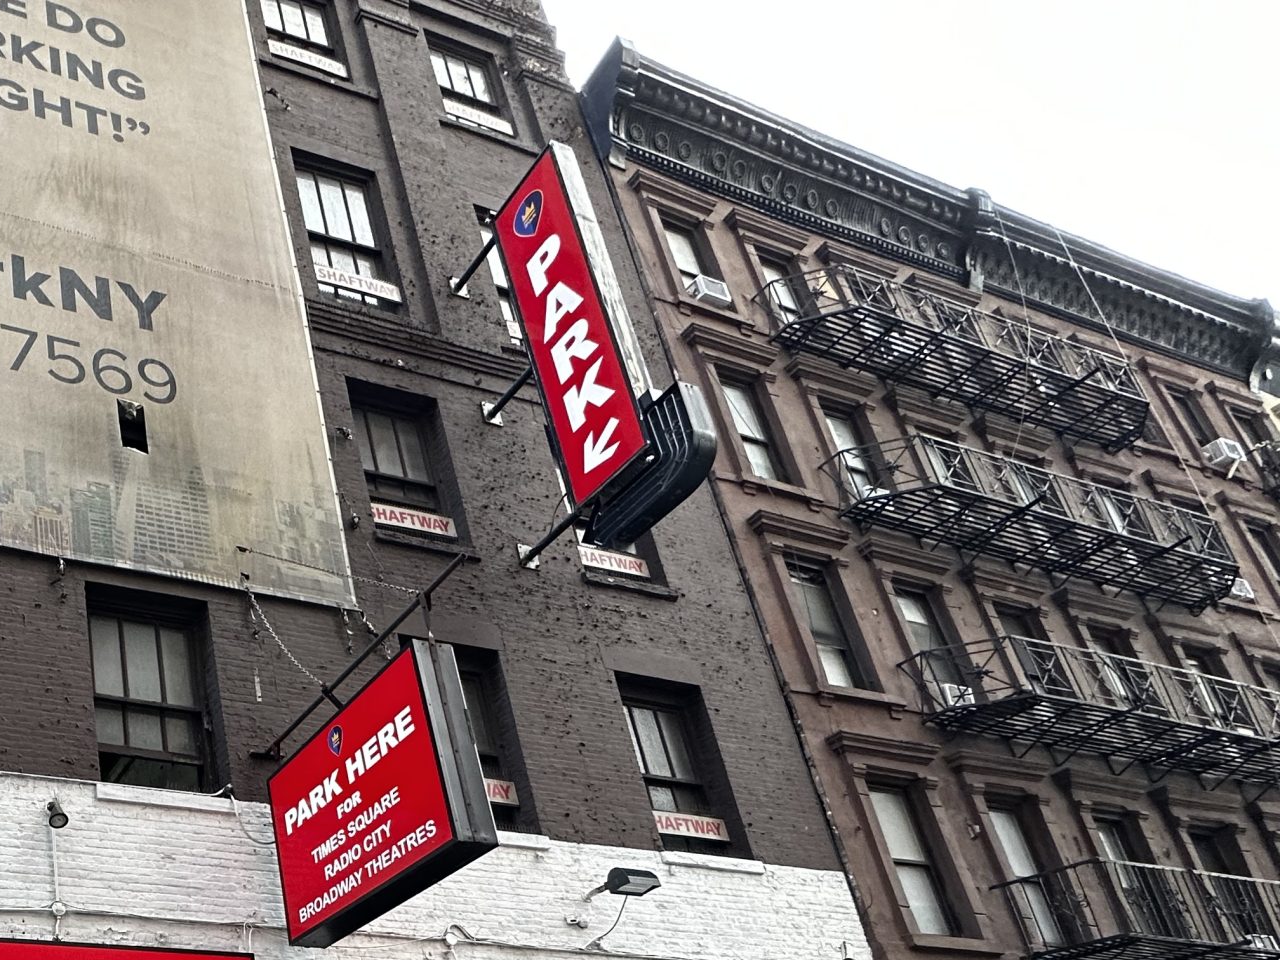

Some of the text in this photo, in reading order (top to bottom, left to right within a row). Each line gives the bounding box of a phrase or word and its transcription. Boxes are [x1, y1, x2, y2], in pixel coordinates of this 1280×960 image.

[45, 0, 126, 48] DO
[318, 268, 398, 297] SHAFTWAY
[525, 233, 616, 433] PARK
[371, 507, 450, 532] SHAFTWAY
[581, 551, 645, 574] HAFTWAY
[284, 705, 416, 836] PARK HERE
[310, 785, 401, 864] TIMES SQUARE
[336, 790, 362, 820] FOR
[655, 818, 721, 837] HAFTWAY
[298, 819, 437, 923] BROADWAY THEATRES
[323, 820, 392, 881] RADIO CITY
